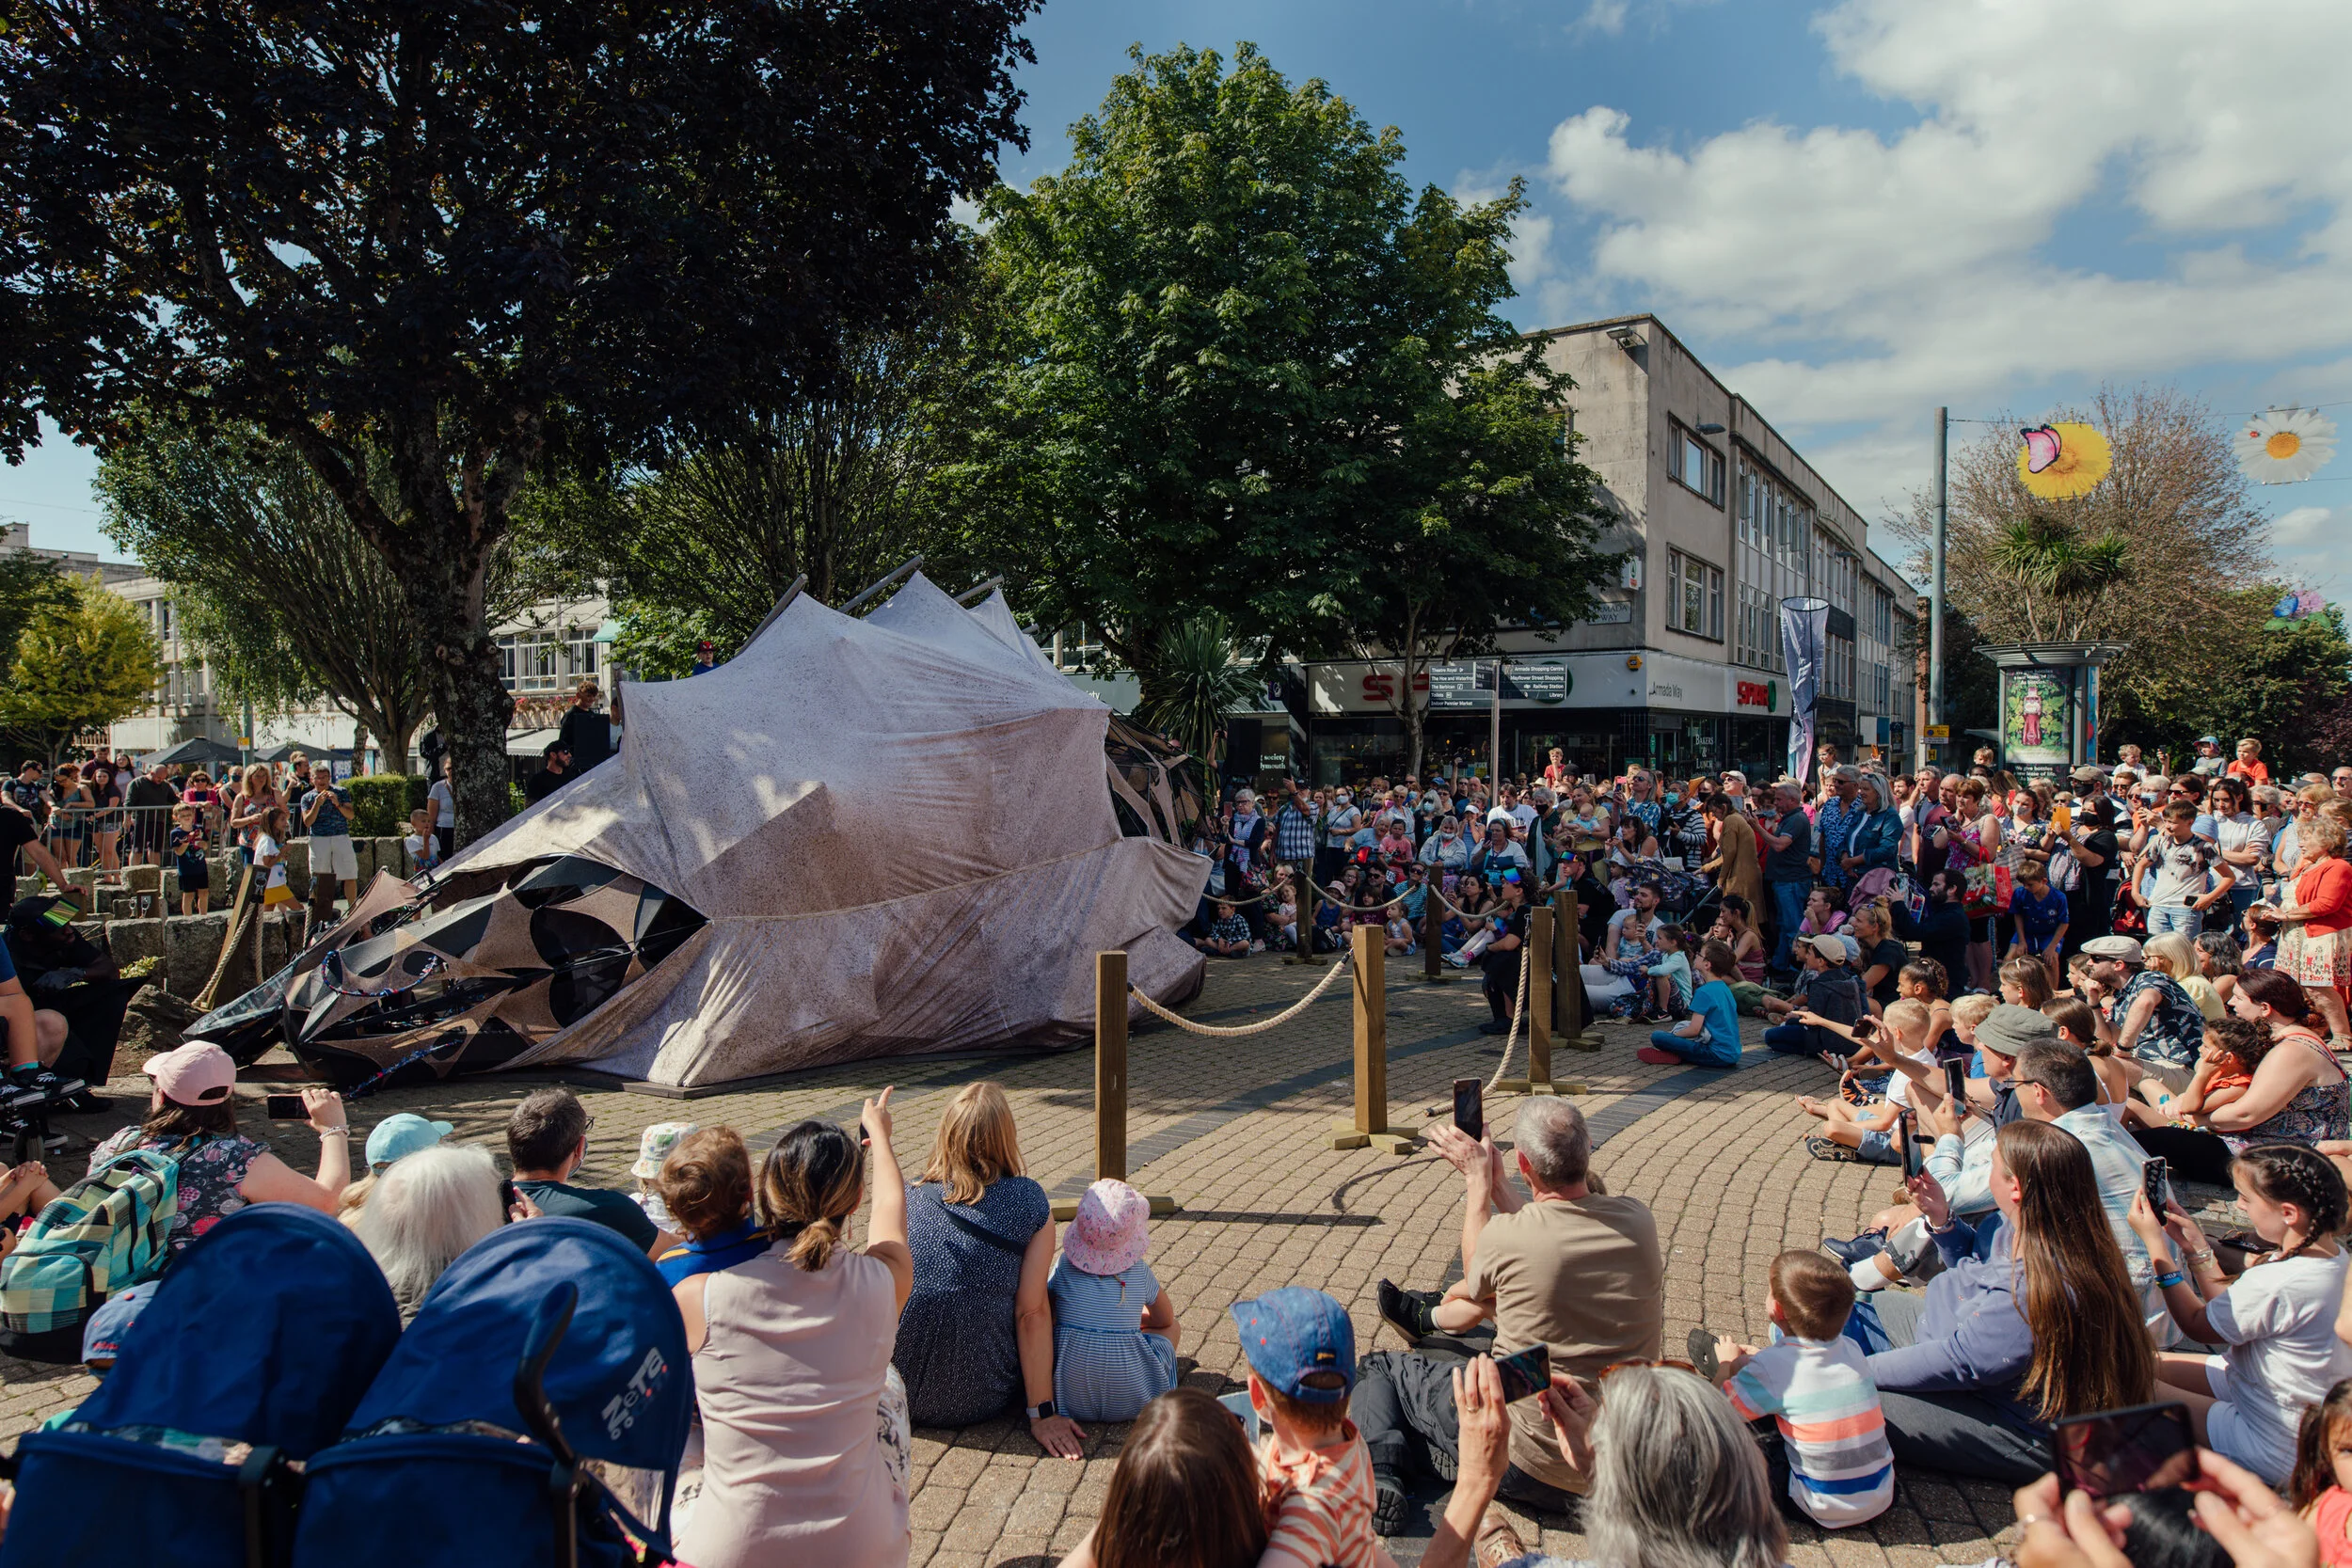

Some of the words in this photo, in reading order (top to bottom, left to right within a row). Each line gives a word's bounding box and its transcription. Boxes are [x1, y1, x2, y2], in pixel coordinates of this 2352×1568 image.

[1600, 612, 1619, 621] WAY
[1672, 684, 1683, 702] Way
[1738, 681, 1769, 706] SPAR
[1264, 752, 1286, 763] society
[1260, 762, 1286, 771] lymouth
